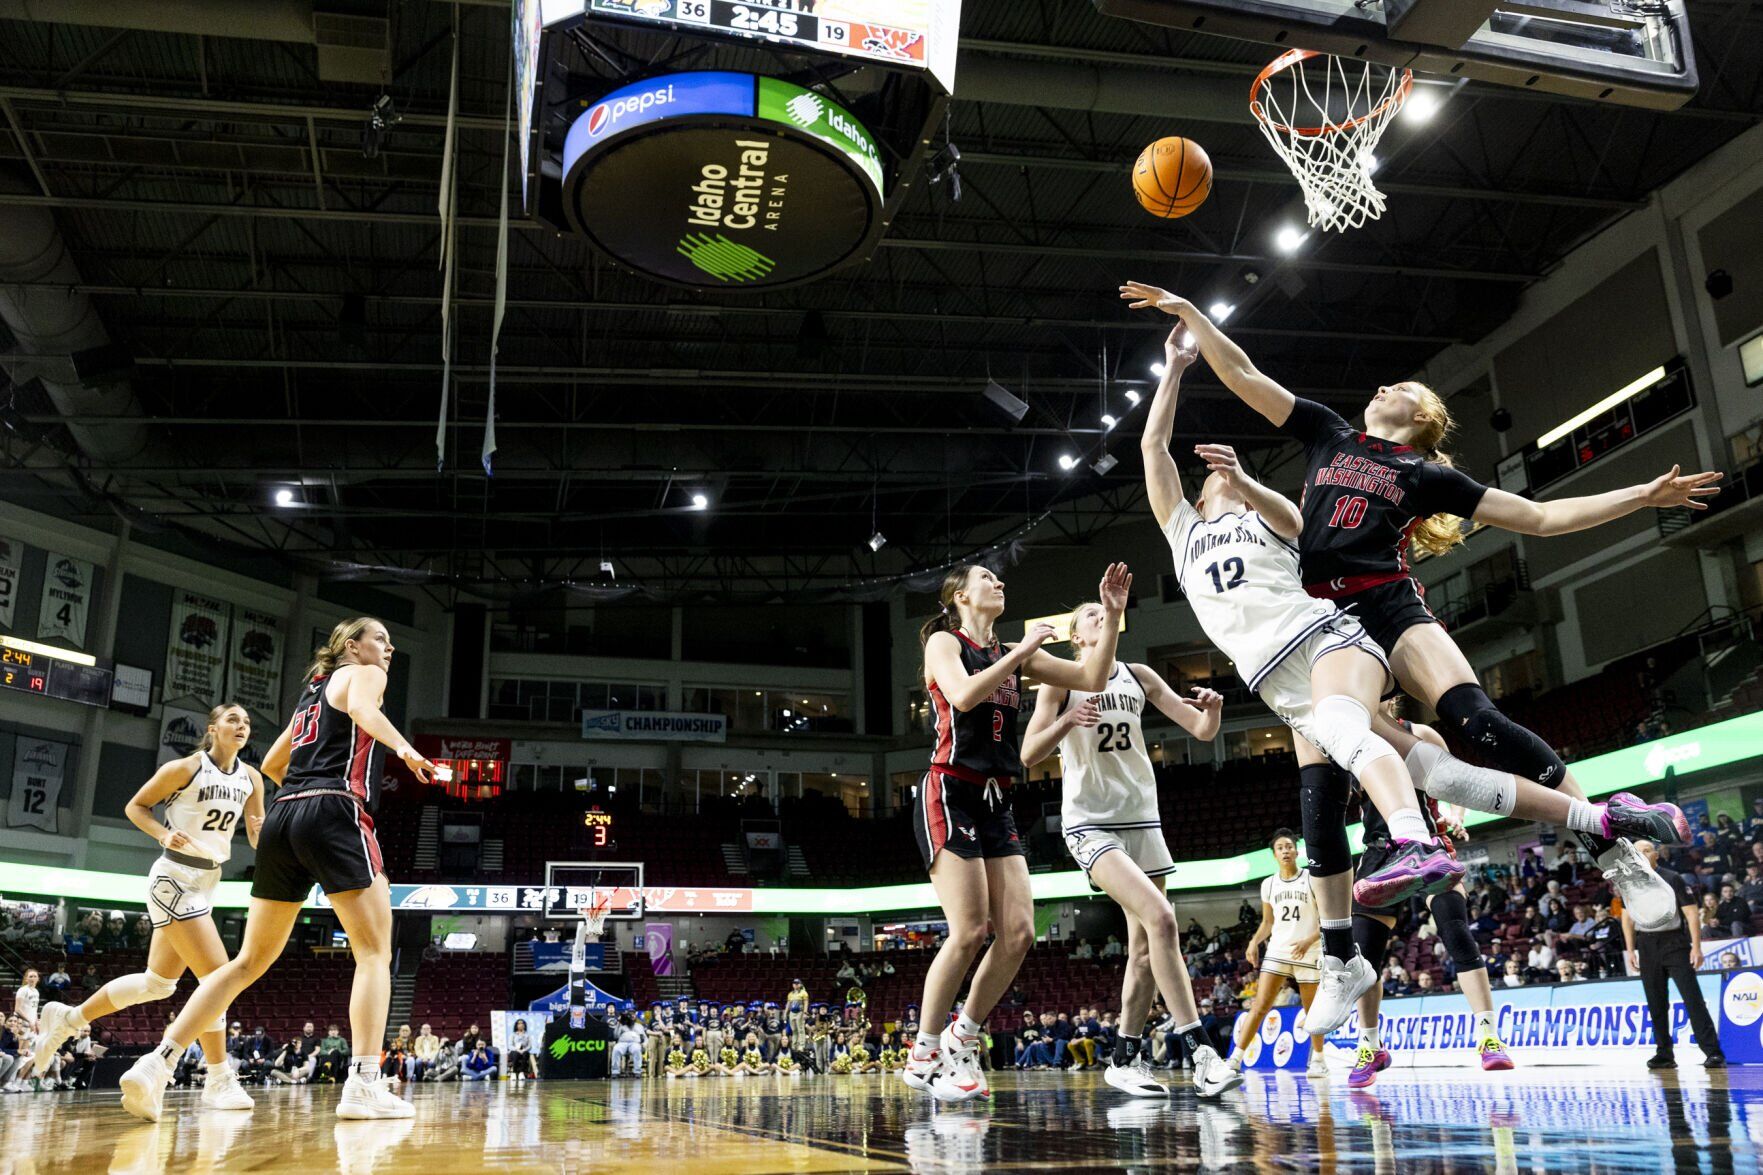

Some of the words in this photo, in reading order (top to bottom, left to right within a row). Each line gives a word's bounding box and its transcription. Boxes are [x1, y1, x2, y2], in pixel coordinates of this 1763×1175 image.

[681, 1, 706, 18] 36
[730, 5, 798, 36] 2:45
[825, 25, 845, 40] 19
[613, 84, 673, 123] pepsi
[828, 108, 868, 152] Idaho
[688, 164, 728, 227] Idaho
[723, 140, 770, 229] Central
[764, 174, 789, 231] ARENA
[1330, 451, 1401, 482] EASTERN
[1315, 468, 1406, 506] WASHINGTON
[1328, 494, 1369, 529] 10
[1205, 556, 1249, 594] 12
[56, 603, 72, 627] 4
[2, 649, 31, 666] 2:44
[5, 673, 14, 684] 2
[30, 677, 44, 692] 19
[1086, 692, 1118, 712] TANA
[1119, 693, 1140, 717] STATE
[625, 716, 722, 734] CHAMPIONSHIP
[992, 709, 1004, 743] 2
[1097, 721, 1132, 753] 23
[23, 788, 46, 814] 12
[197, 784, 231, 802] MONTANA
[202, 808, 235, 831] 20
[585, 813, 611, 826] 2:44
[595, 825, 606, 846] 3
[492, 892, 509, 904] 36
[573, 893, 588, 904] 19
[1281, 905, 1301, 921] 24
[1732, 993, 1758, 1001] NAU
[1375, 1012, 1478, 1051] ASKETBAL
[1497, 1003, 1697, 1046] CHAMPIONSHP
[571, 1039, 605, 1051] ICCU
